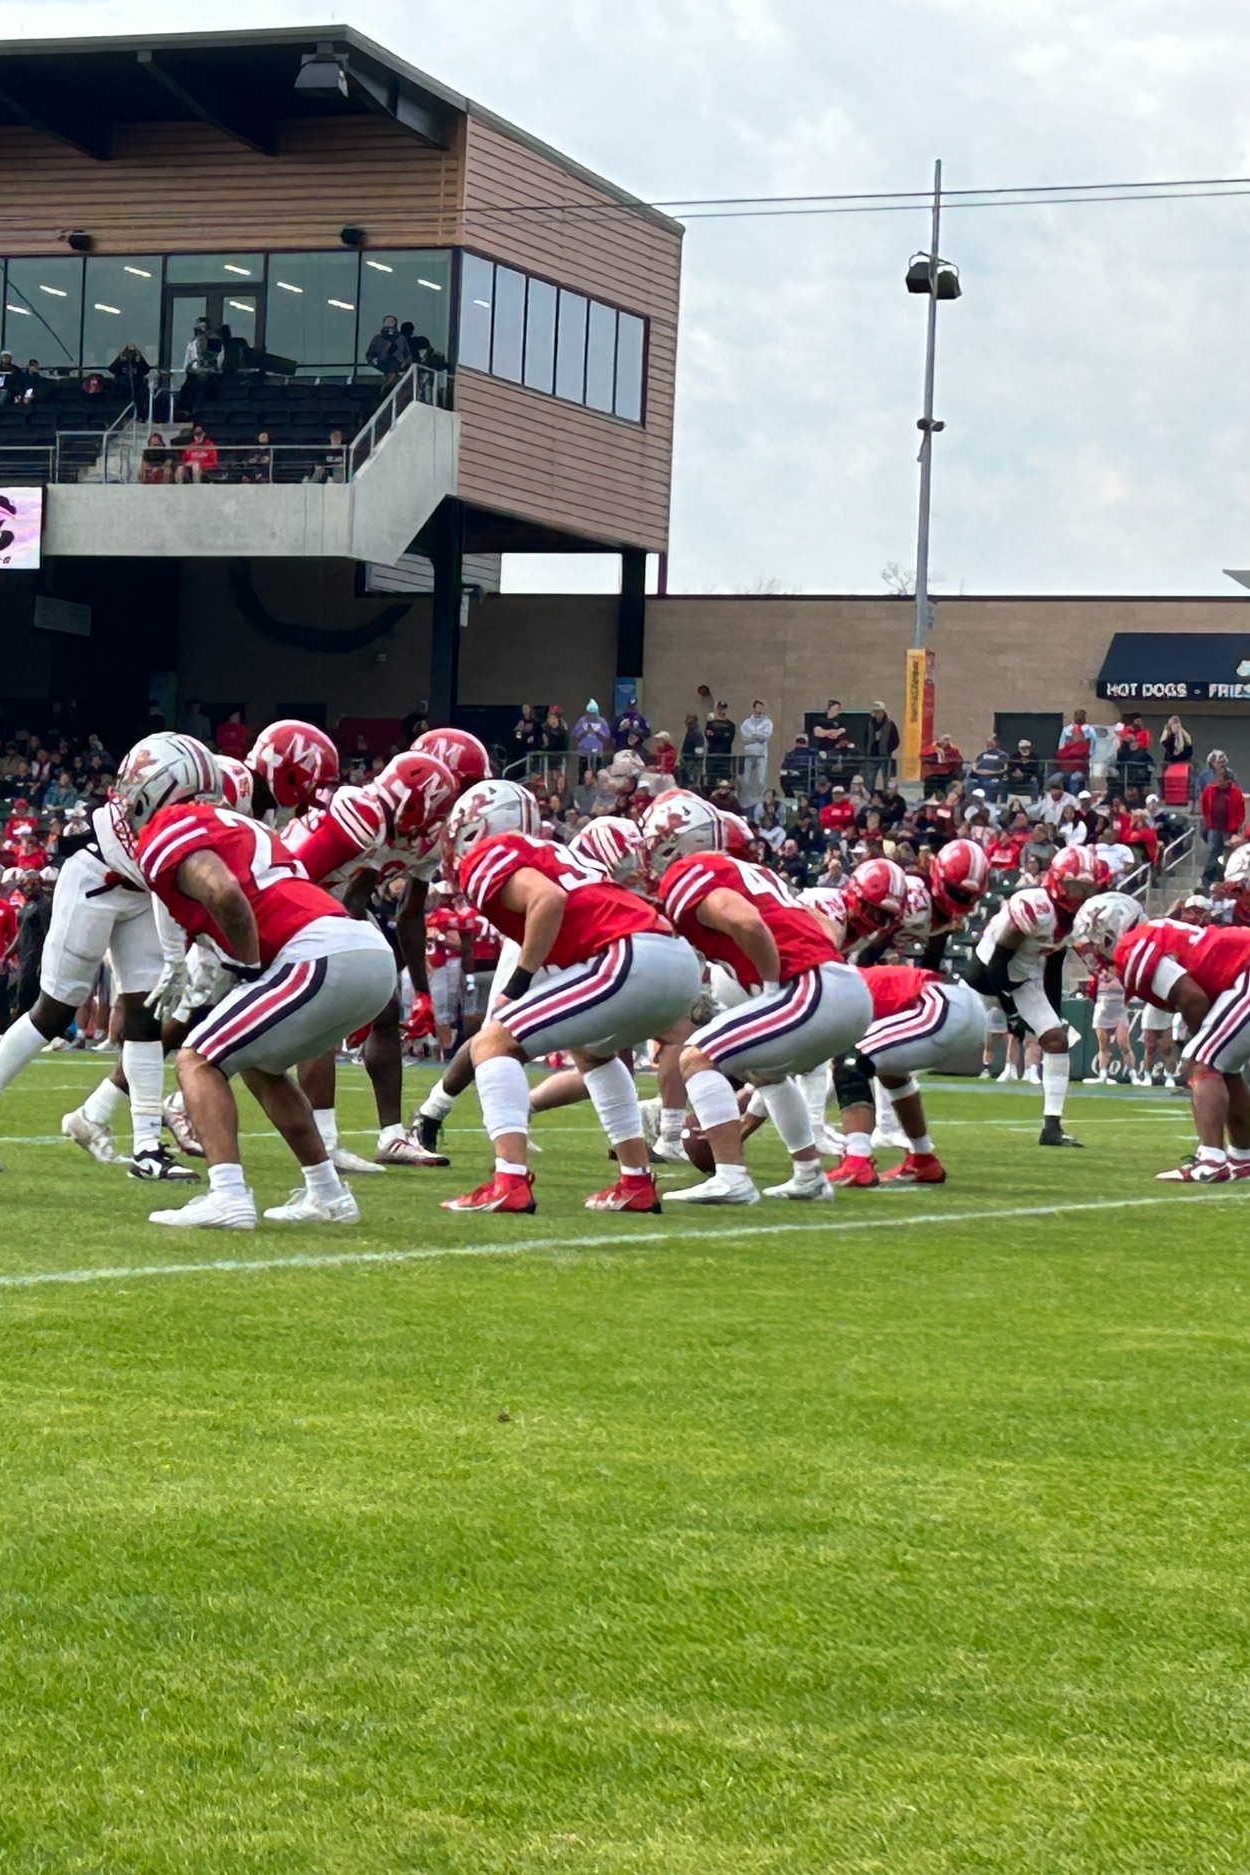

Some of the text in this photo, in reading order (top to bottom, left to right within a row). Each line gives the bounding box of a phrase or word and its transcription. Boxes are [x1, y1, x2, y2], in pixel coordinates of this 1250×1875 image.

[1107, 683, 1138, 697] HOT
[1142, 683, 1187, 698] DOGS
[282, 733, 325, 790] M
